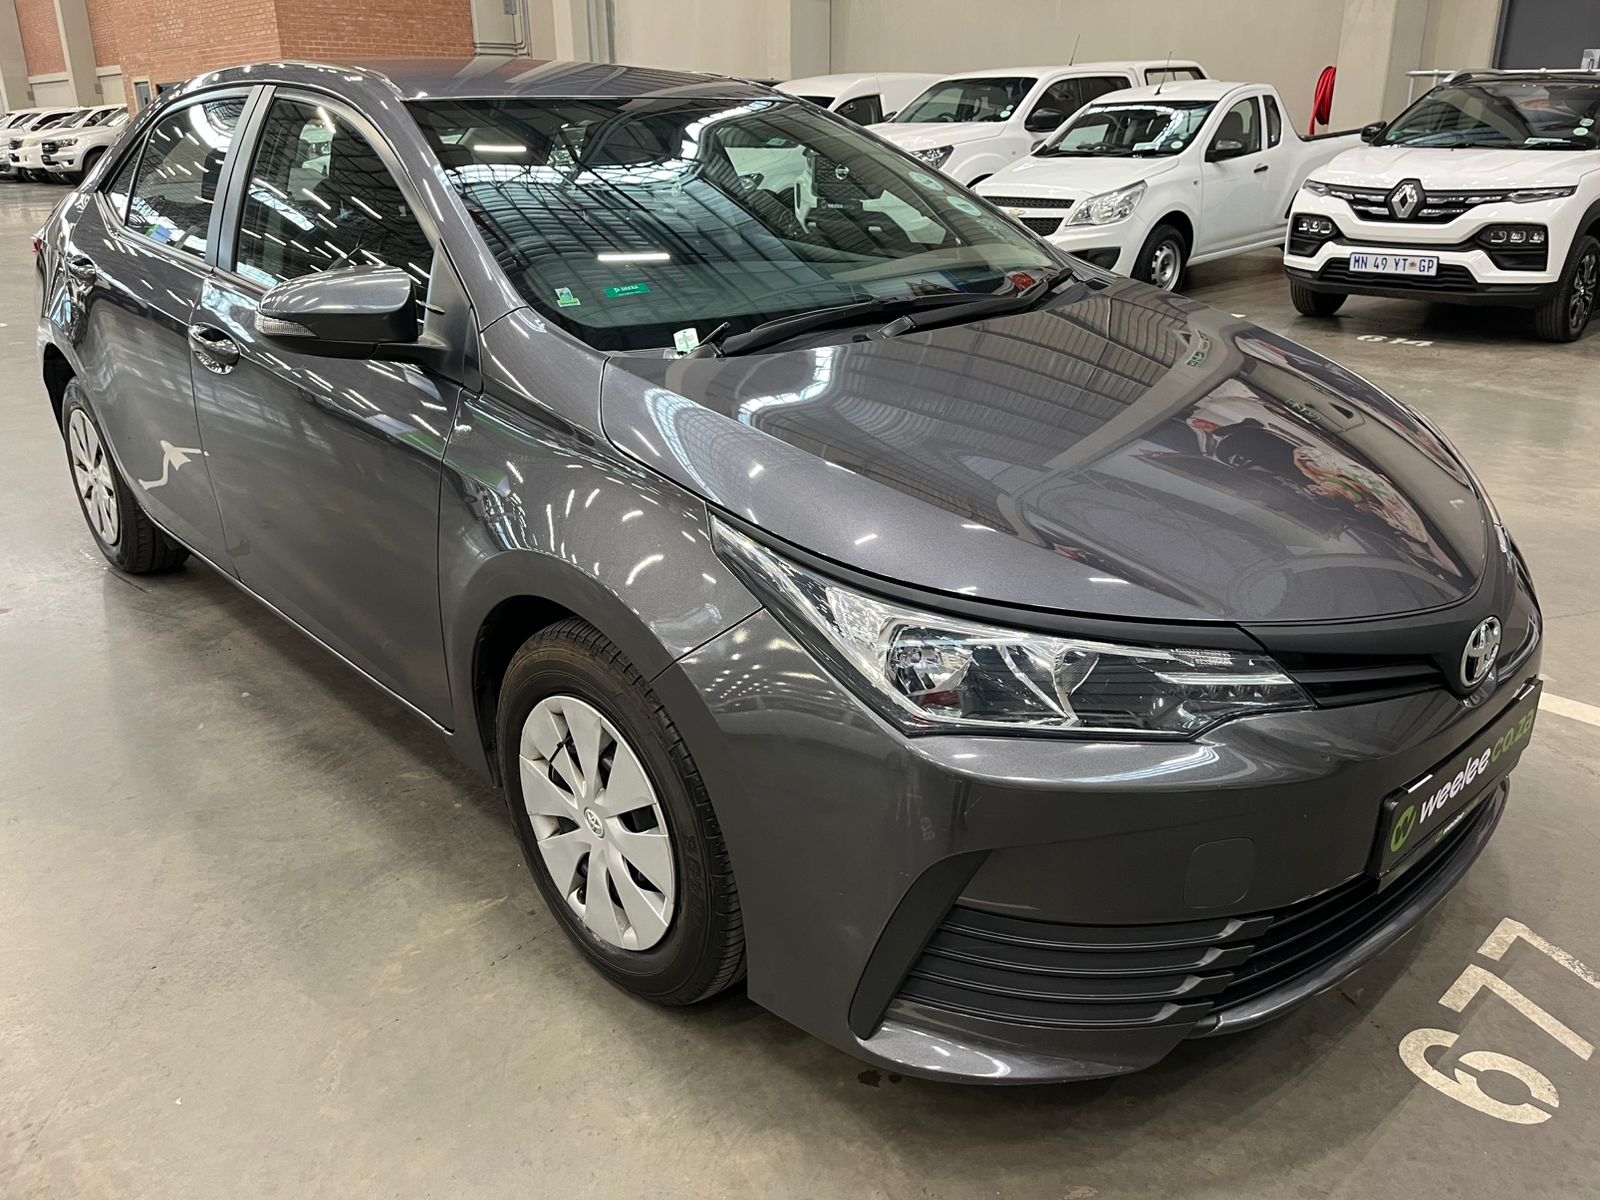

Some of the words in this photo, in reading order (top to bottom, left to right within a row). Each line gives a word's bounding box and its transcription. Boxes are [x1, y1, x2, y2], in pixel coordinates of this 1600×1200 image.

[1353, 255, 1368, 269] MN
[1374, 257, 1388, 271] 49
[1394, 258, 1408, 272] YT
[1418, 259, 1434, 273] GP
[1419, 748, 1491, 824] weelee
[1399, 917, 1600, 1125] 677
